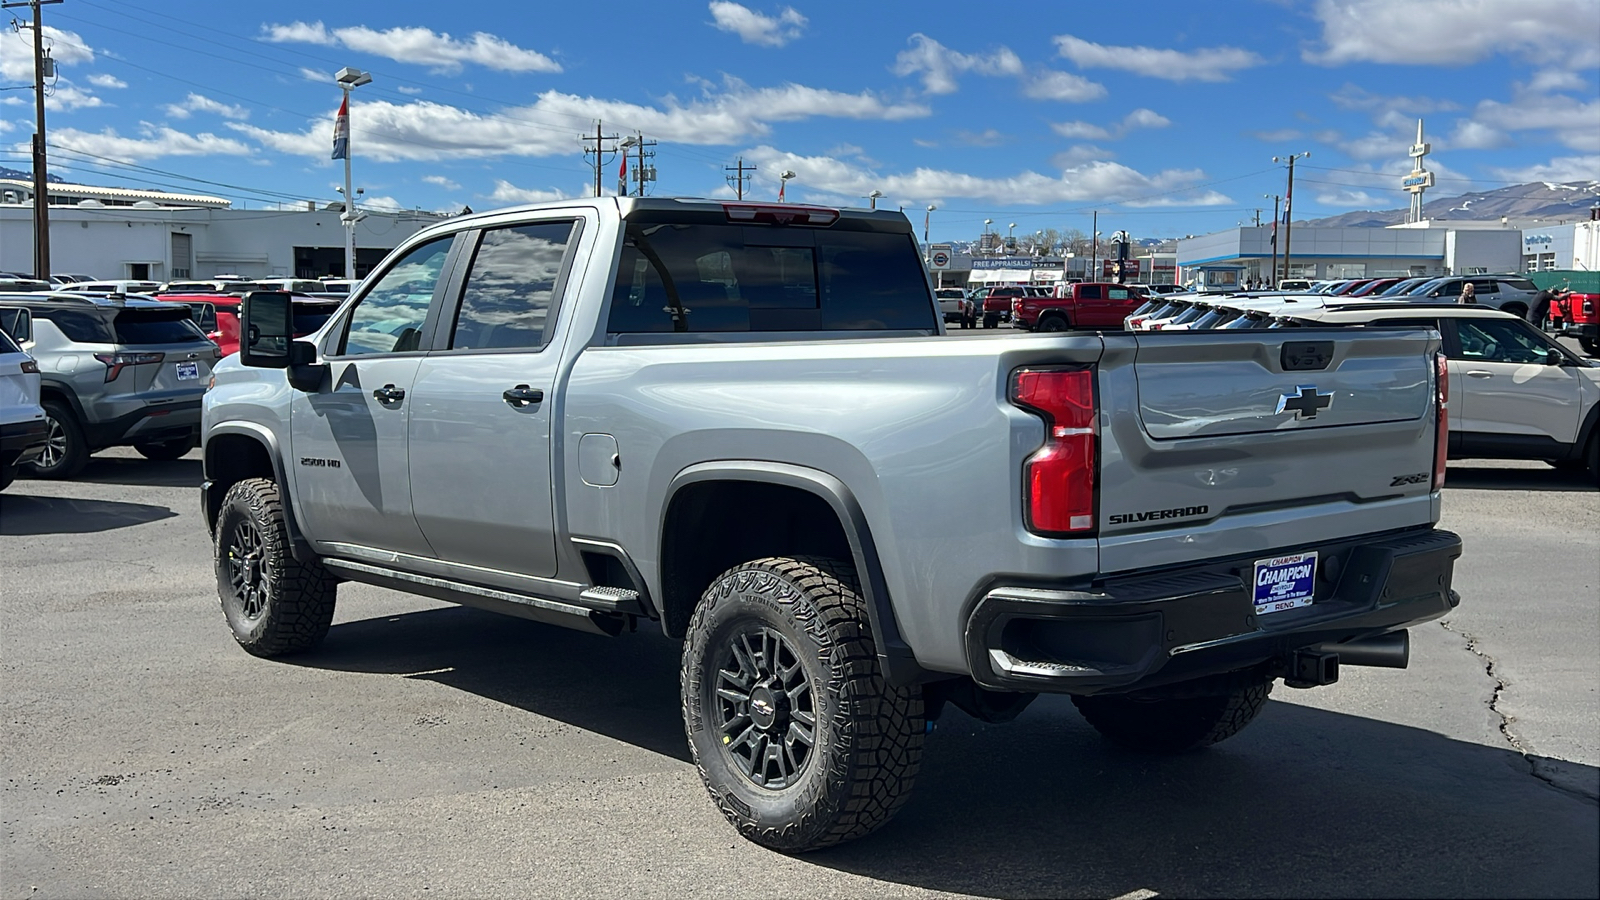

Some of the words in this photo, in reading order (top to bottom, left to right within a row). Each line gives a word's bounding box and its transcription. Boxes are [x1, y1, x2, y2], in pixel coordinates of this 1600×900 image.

[300, 457, 325, 467] 2500
[327, 459, 341, 468] HD
[1389, 472, 1429, 487] ZR2
[1109, 505, 1209, 525] SILVERADO
[1271, 556, 1302, 566] CHAMPION
[1257, 565, 1311, 586] CHAMPION
[1275, 601, 1295, 611] RENO
